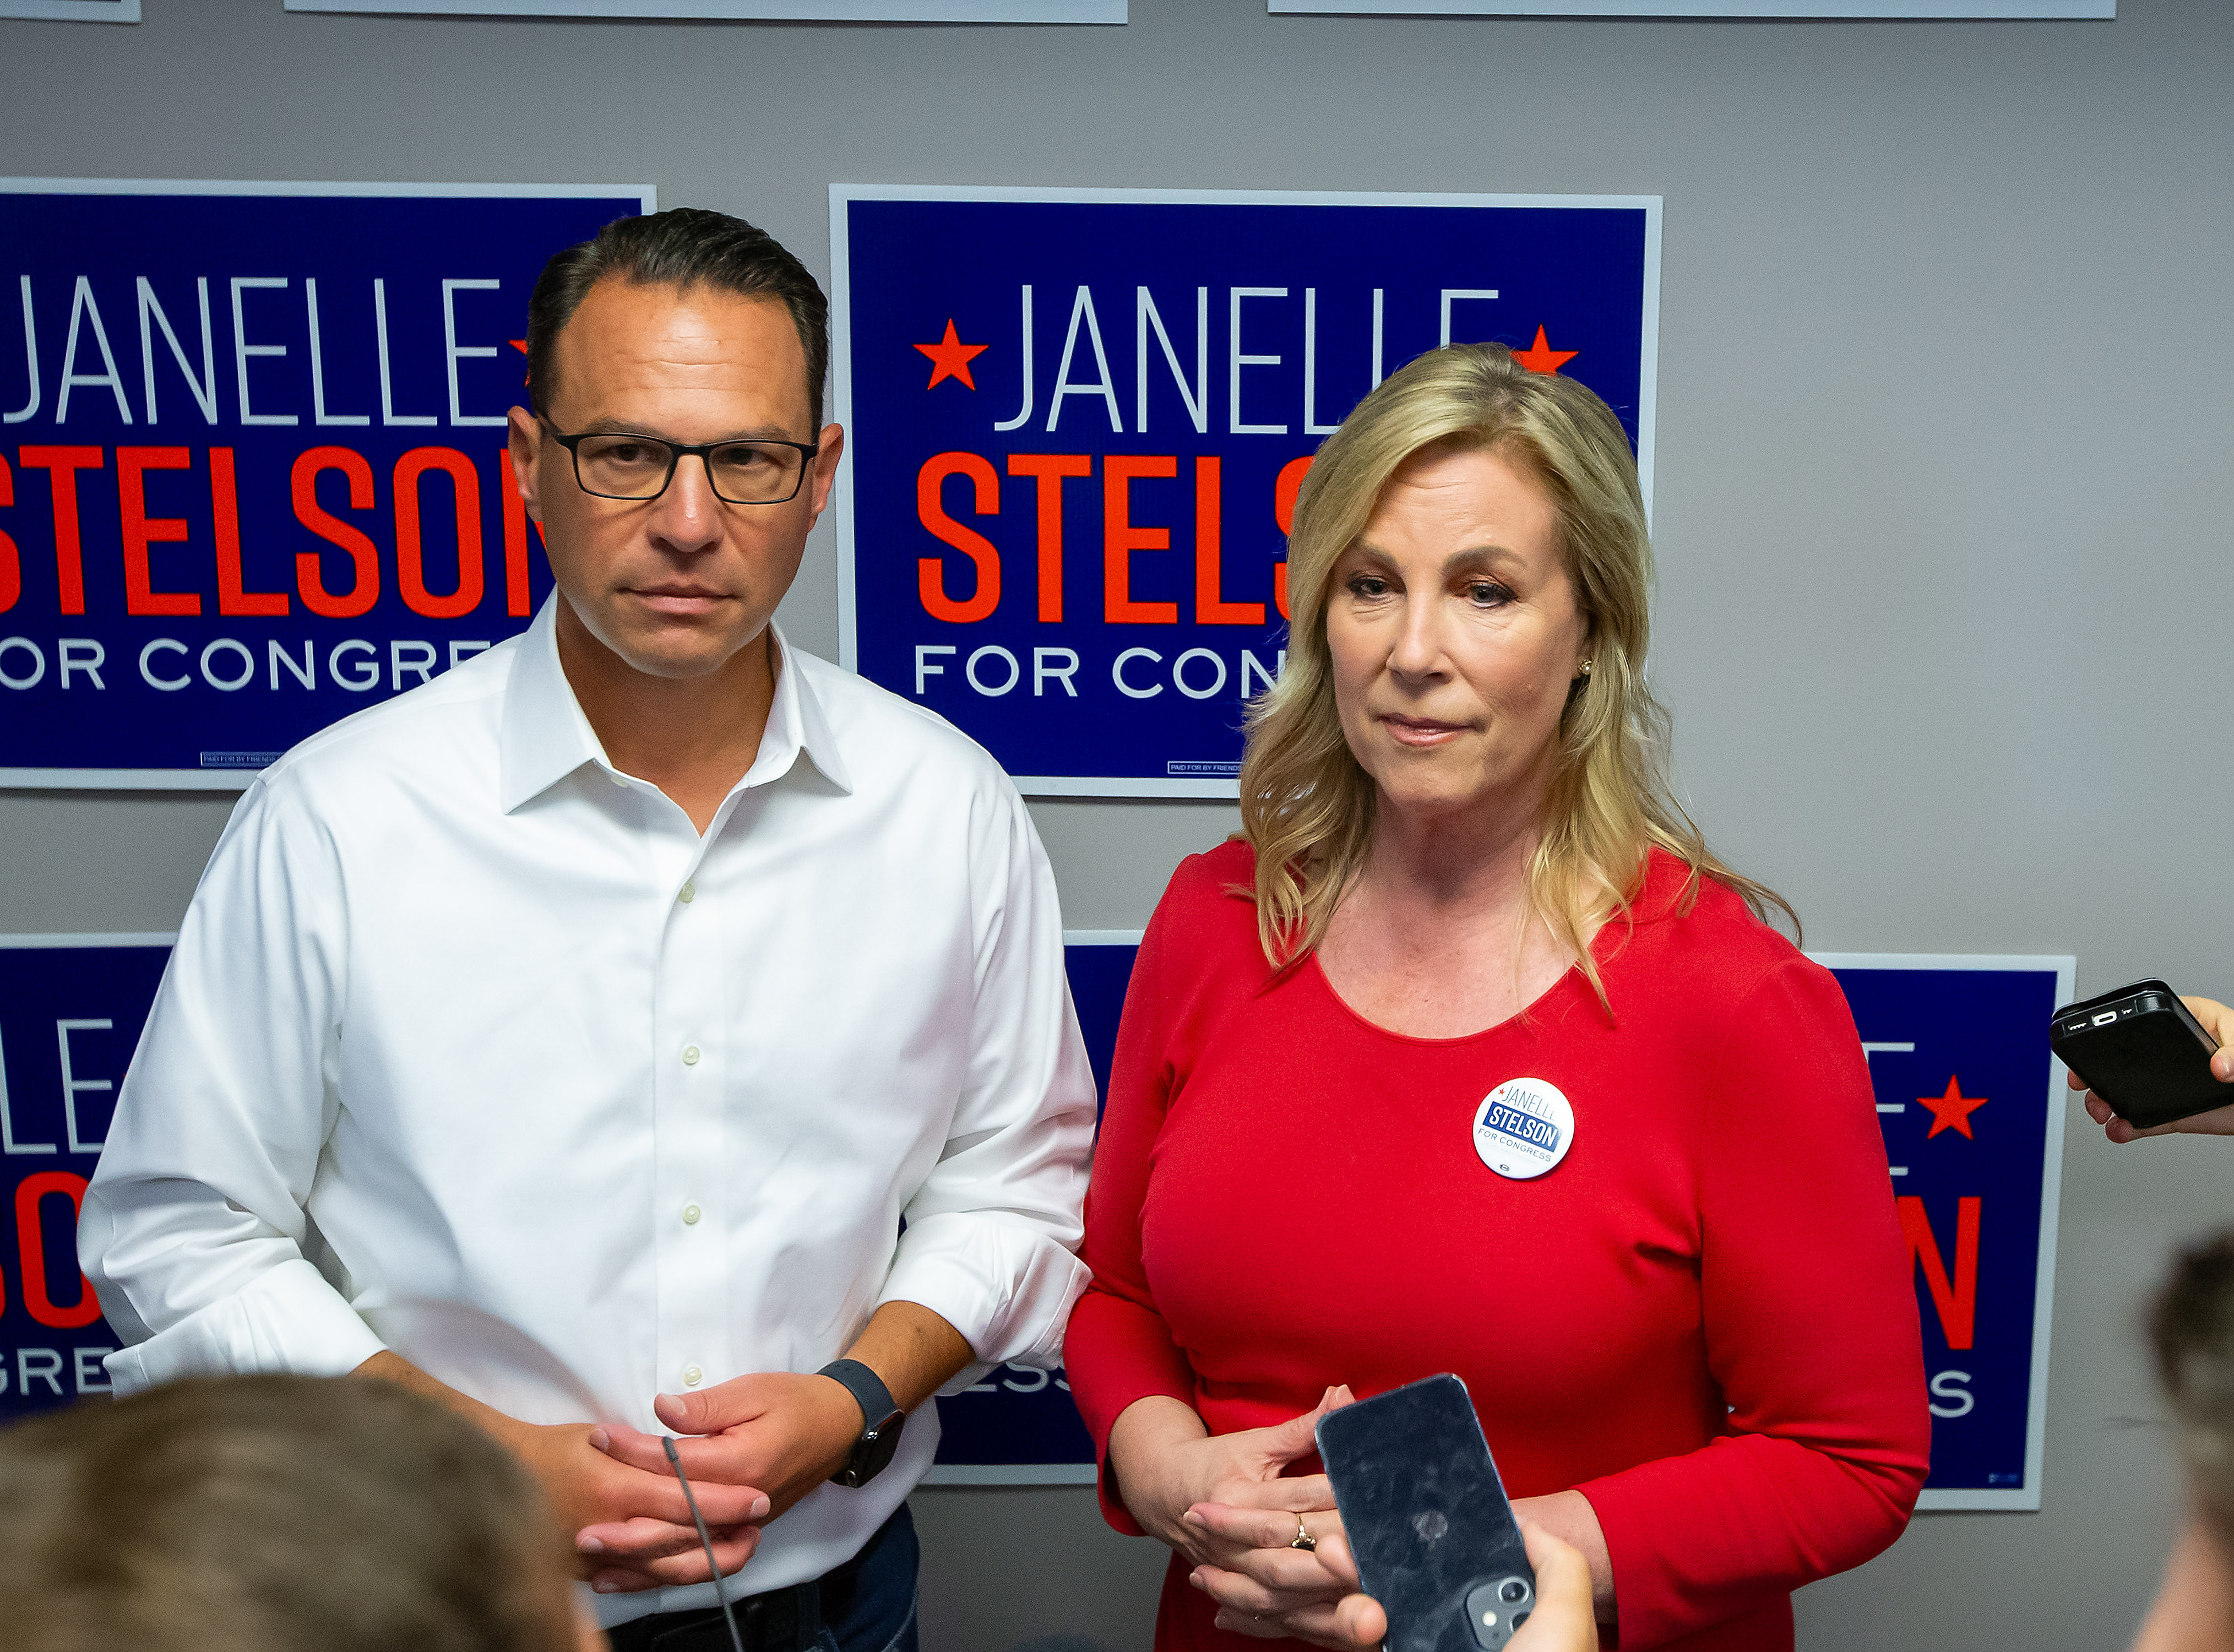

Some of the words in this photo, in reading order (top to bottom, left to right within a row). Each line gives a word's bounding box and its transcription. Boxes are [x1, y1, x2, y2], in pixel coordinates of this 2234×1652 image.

[3, 275, 508, 427] JANELLE
[0, 444, 546, 618] TELSO
[915, 645, 1079, 697] FOR
[1478, 1128, 1498, 1141] FOR
[1499, 1137, 1551, 1162] CONGRESS
[1488, 1105, 1558, 1148] STELSON
